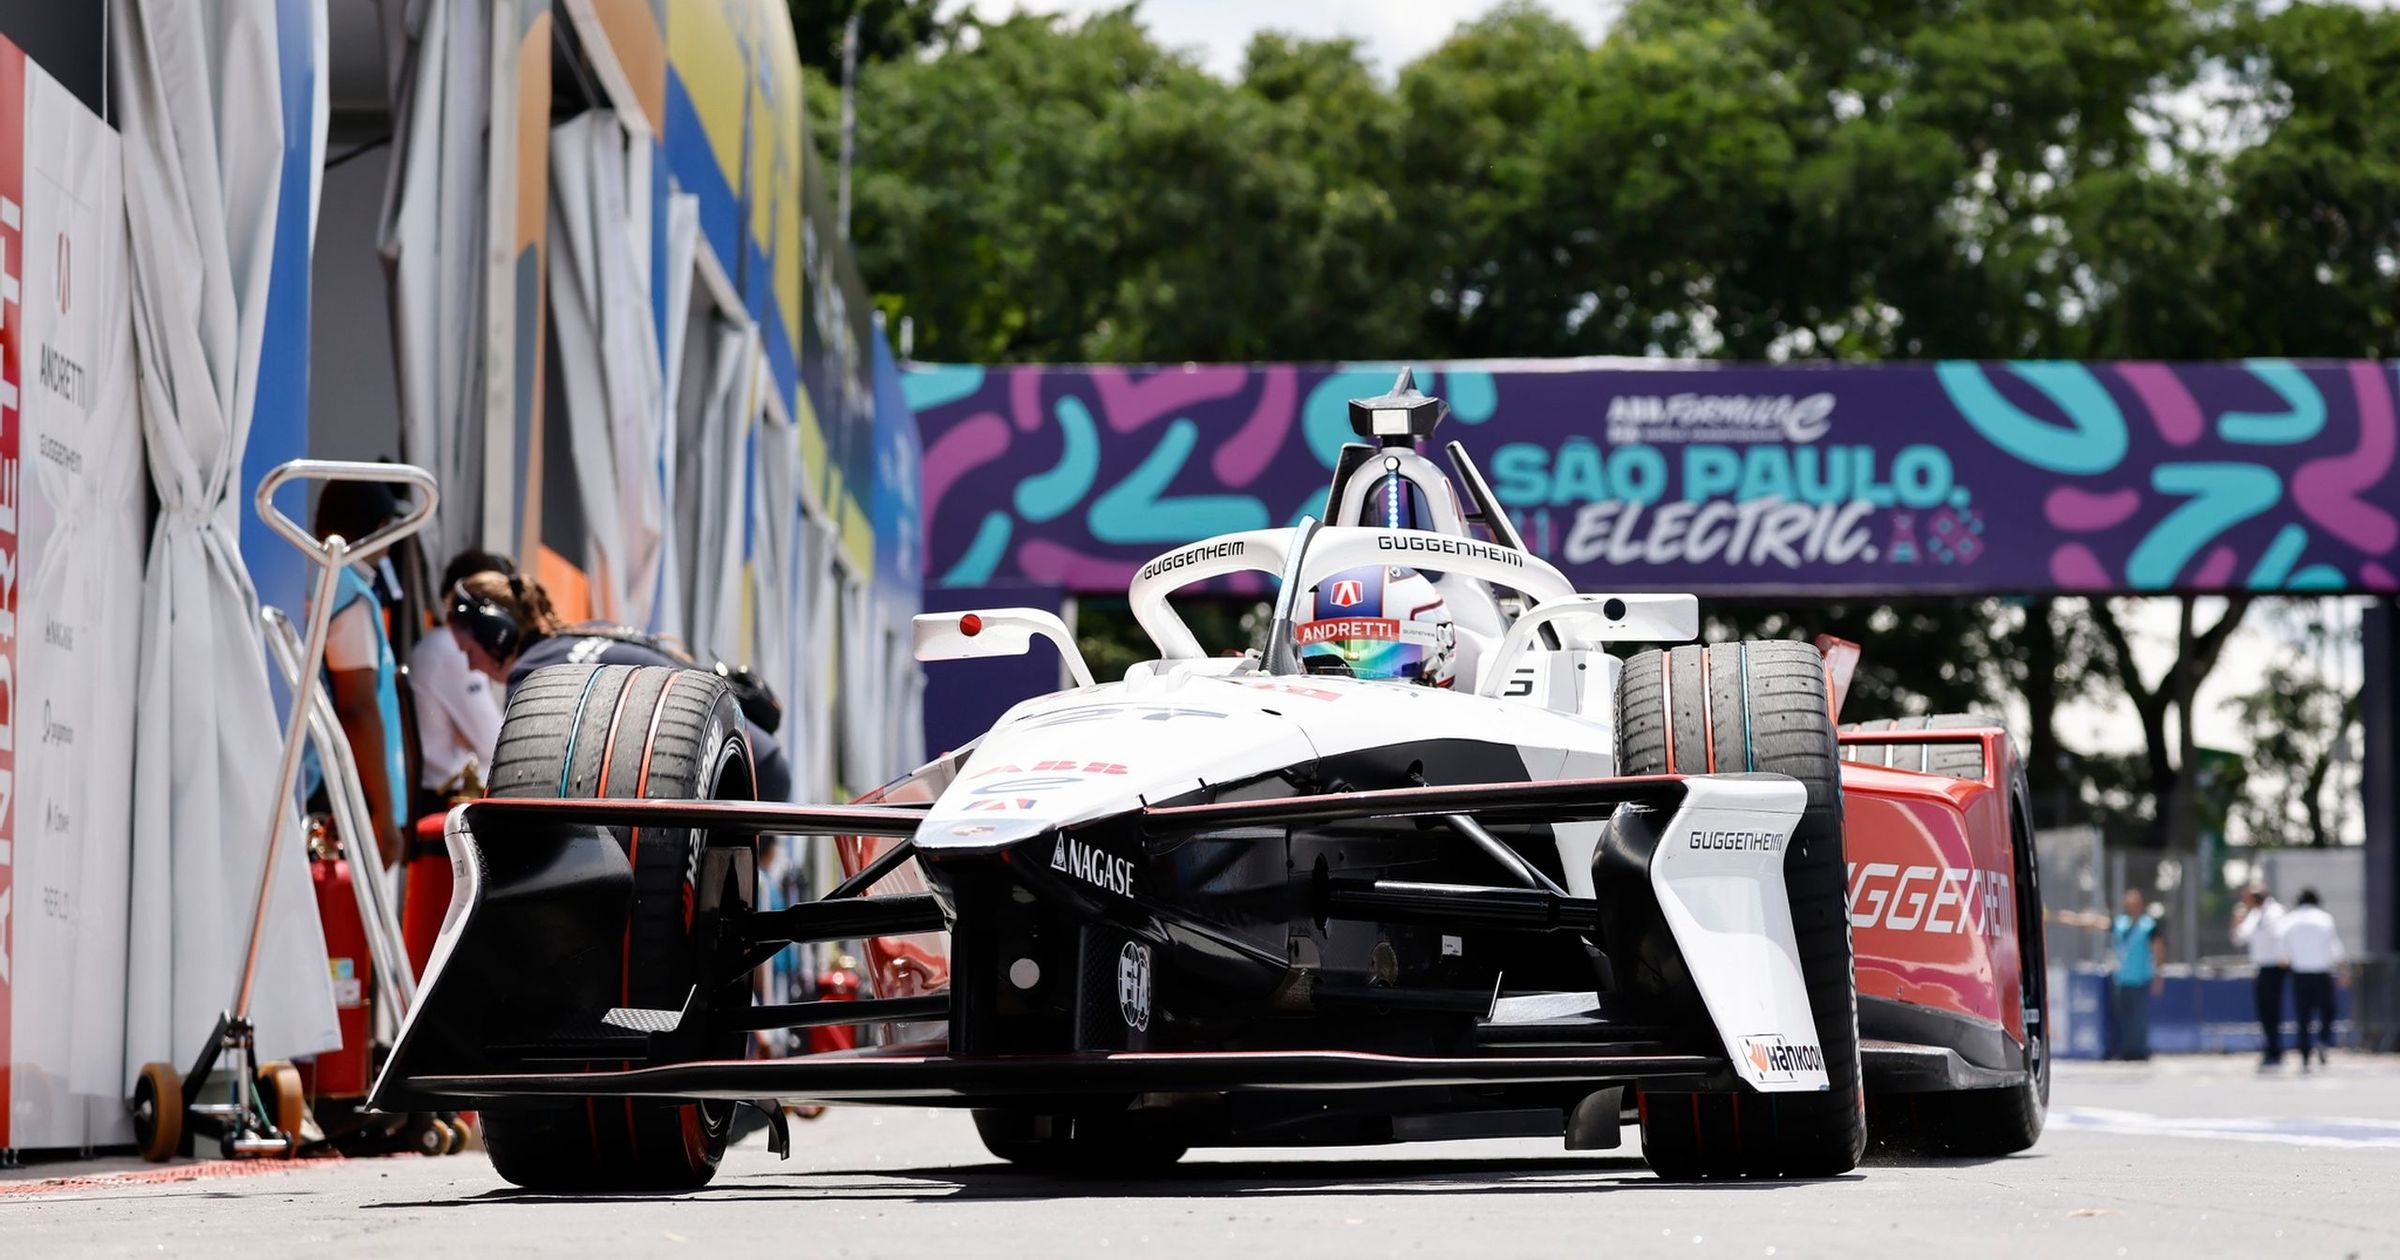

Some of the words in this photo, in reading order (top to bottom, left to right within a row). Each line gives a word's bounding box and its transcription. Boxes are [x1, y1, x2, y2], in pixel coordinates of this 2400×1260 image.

[1488, 435, 1668, 507] SÃO
[1682, 444, 1971, 508] PAULO.
[1378, 535, 1525, 568] GUGGENHEIM
[1563, 498, 1880, 568] ELECTRIC.
[1143, 540, 1246, 581] GUGGENHEIM
[1302, 621, 1393, 643] ANDRETTI
[1689, 831, 1784, 852] GUGGENHEIM
[1068, 836, 1135, 899] NAGASE
